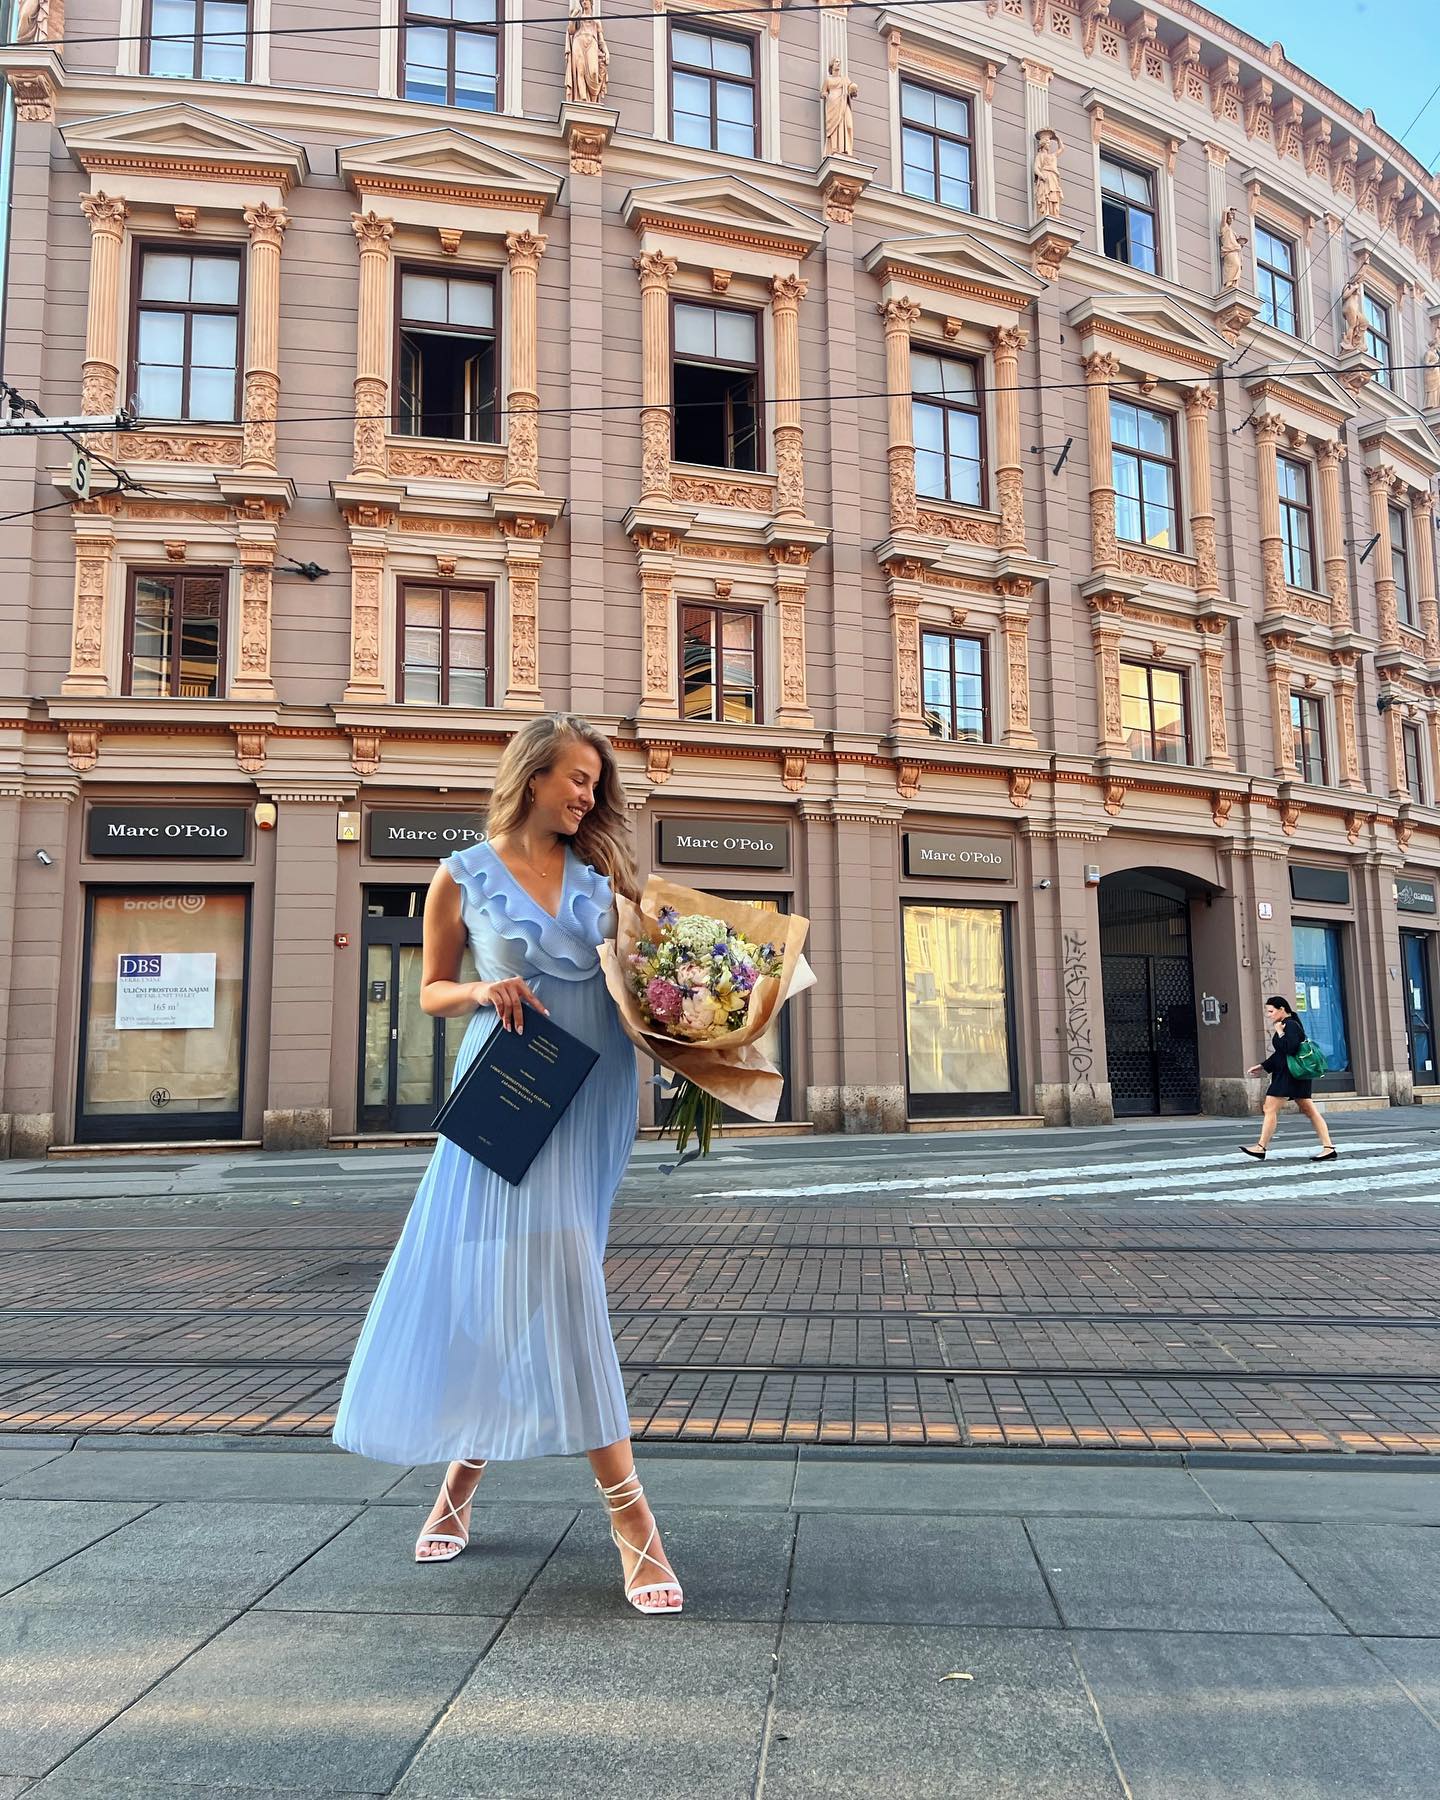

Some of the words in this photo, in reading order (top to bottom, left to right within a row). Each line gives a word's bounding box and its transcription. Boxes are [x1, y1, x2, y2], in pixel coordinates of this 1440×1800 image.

[76, 459, 86, 490] S
[107, 824, 159, 837] Marc
[164, 824, 228, 837] O'Polo
[388, 827, 438, 840] Marc
[442, 828, 489, 841] O'Pol
[676, 835, 719, 849] Marc
[723, 837, 774, 851] O'Polo
[920, 849, 956, 861] Marc
[959, 851, 1002, 864] O'Polo
[123, 959, 160, 974] DBS
[153, 1003, 166, 1011] 165
